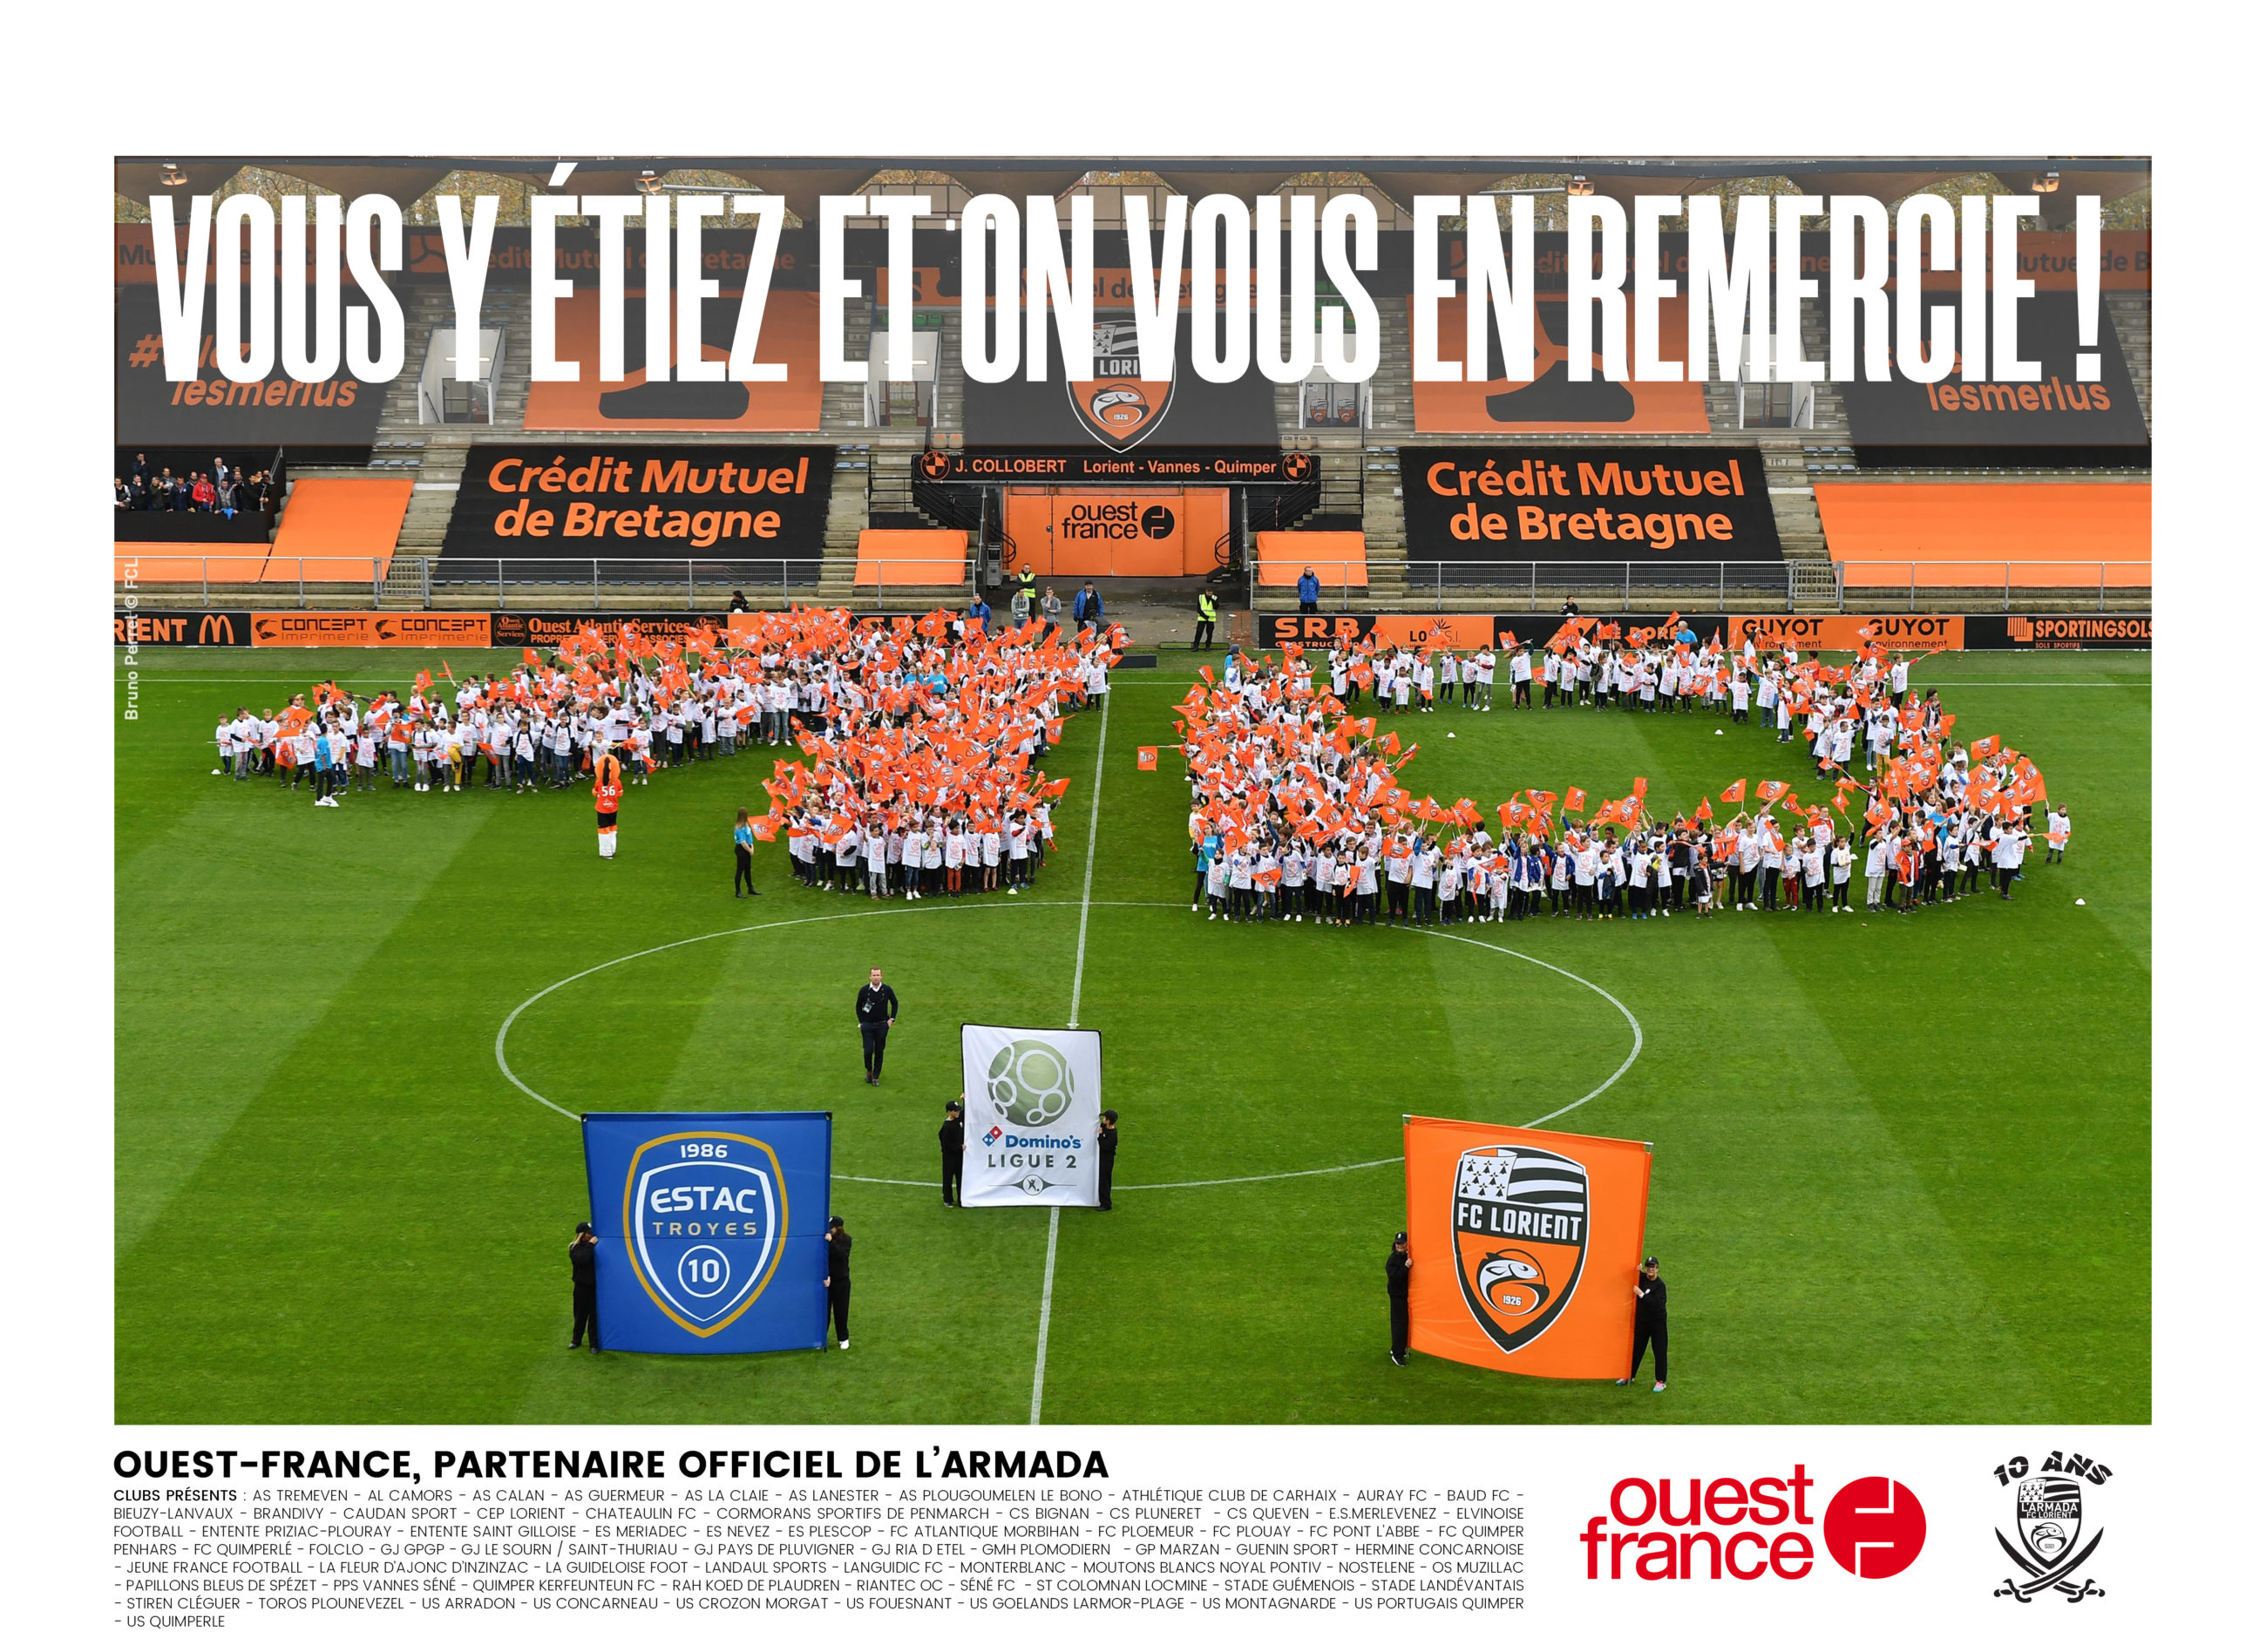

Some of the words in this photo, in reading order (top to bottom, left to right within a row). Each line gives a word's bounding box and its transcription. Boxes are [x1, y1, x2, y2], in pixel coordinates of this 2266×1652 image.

[1926, 376, 2112, 411] lesmerlus
[488, 456, 633, 494] Crédit
[641, 457, 810, 495] Mutuel
[955, 459, 968, 472] J.
[972, 458, 1068, 473] COLLOBERT
[1083, 459, 1135, 473] Lorient
[1147, 460, 1200, 473] Vannes
[1214, 459, 1277, 477] Quimper
[1427, 459, 1570, 497] Crédit
[1577, 459, 1745, 497] Mutuel
[1071, 501, 1138, 521] ouest
[494, 498, 554, 538] de
[563, 502, 781, 548] Bretagne
[1062, 518, 1138, 539] france
[1449, 503, 1508, 540] de
[1516, 505, 1733, 549] Bretagne
[282, 619, 368, 631] CONCEPT
[401, 619, 487, 631] CONCEPT
[528, 618, 572, 633] Ouest
[573, 618, 627, 633] Atlanti
[632, 618, 689, 633] Services
[1274, 617, 1360, 639] SRB
[1741, 619, 1824, 636] GUYOT
[1873, 640, 1948, 649] nvironnement
[600, 785, 616, 797] 56
[680, 1143, 729, 1159] 1986
[988, 1154, 1055, 1168] LIGUE
[1065, 1154, 1077, 1168] 2
[650, 1186, 757, 1214] ESTAC
[653, 1222, 757, 1236] TROYES
[1457, 1202, 1483, 1229] FC
[1490, 1207, 1583, 1242] LORIENT
[688, 1258, 721, 1283] 10
[1503, 1294, 1522, 1306] 1926
